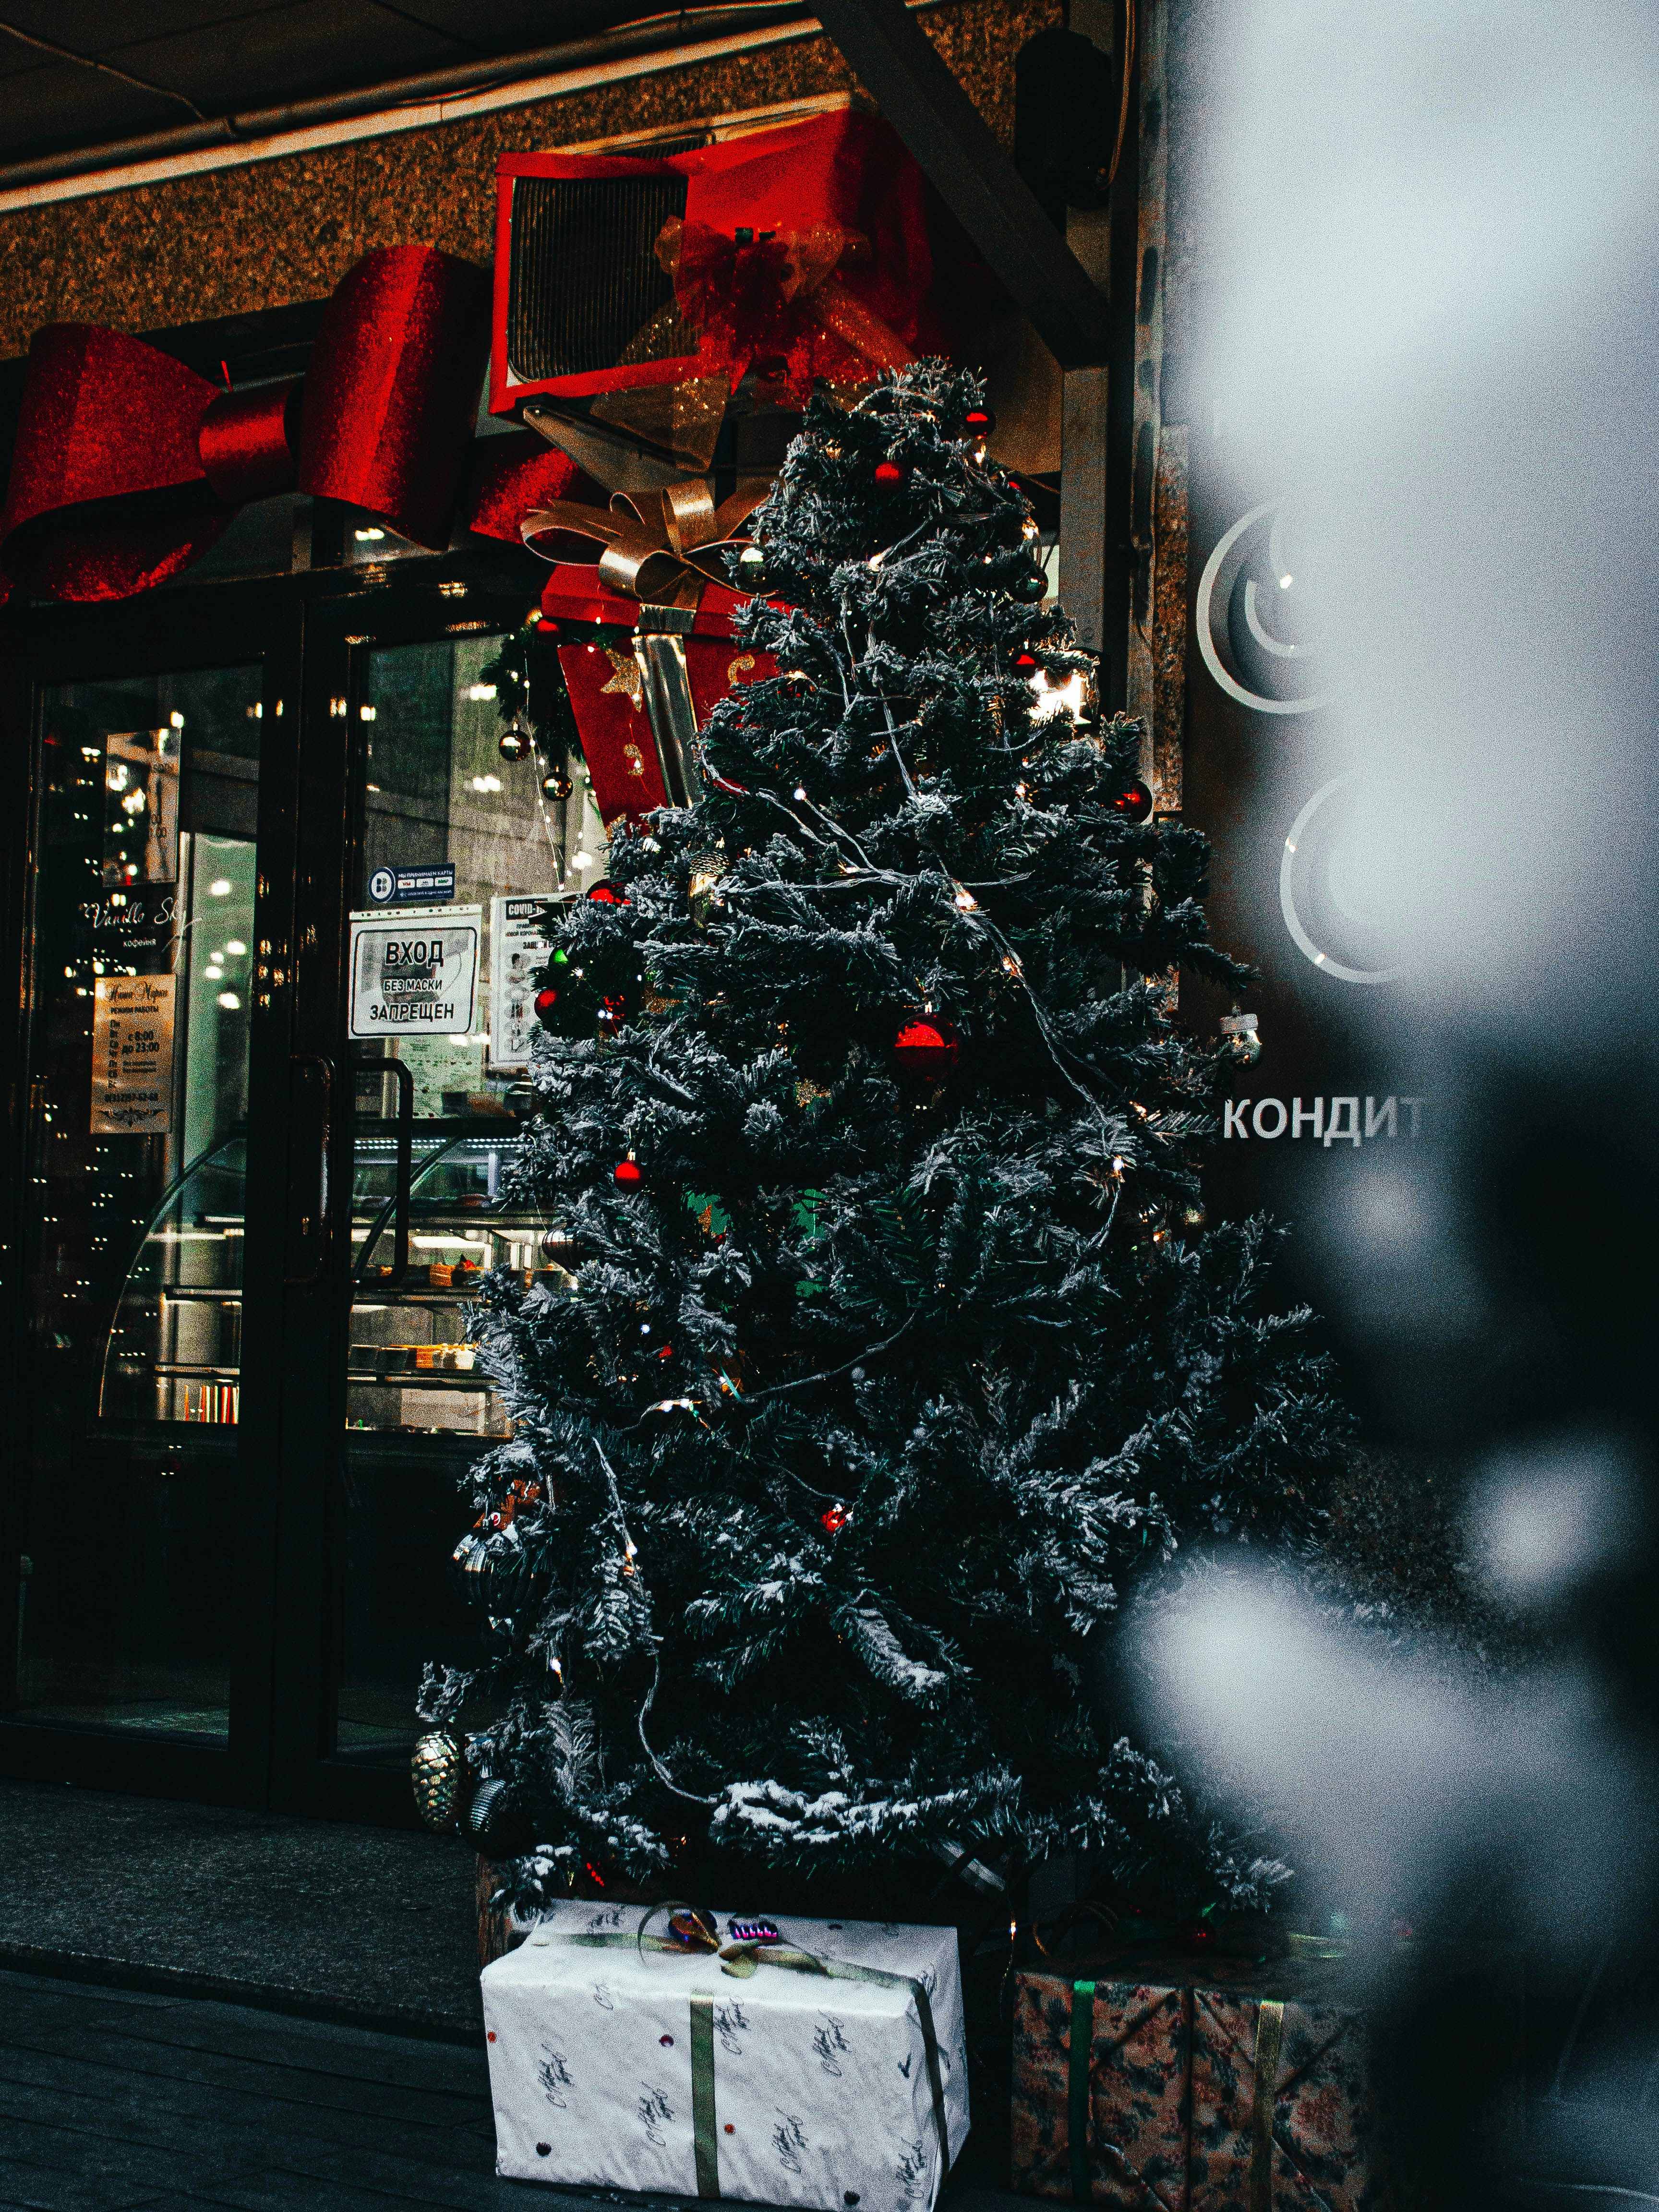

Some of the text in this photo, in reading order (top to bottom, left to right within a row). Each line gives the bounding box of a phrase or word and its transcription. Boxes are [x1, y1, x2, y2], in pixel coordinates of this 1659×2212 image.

[385, 941, 444, 967] ВХОД
[385, 978, 442, 991] БЕЗ МАСКИ
[370, 1003, 454, 1022] ЗАПРЕЩЕН
[135, 1030, 154, 1041] 8:00
[136, 1042, 159, 1053] 23:00
